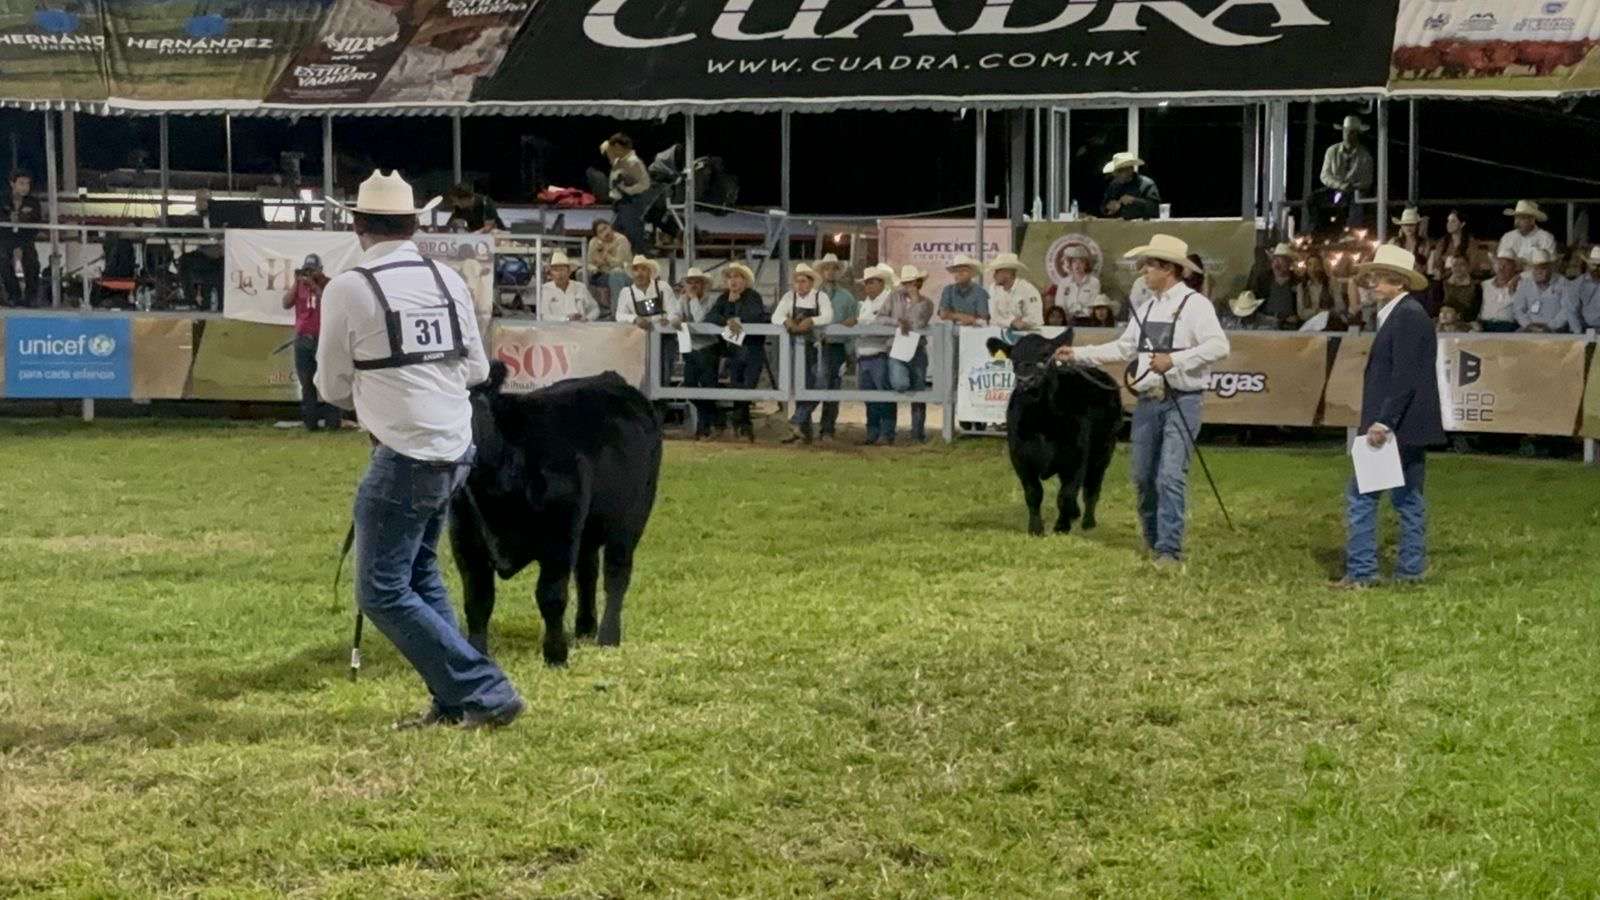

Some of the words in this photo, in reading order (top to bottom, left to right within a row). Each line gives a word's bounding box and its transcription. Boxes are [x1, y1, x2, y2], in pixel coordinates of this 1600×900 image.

[0, 32, 105, 46] HERNÁND
[707, 50, 1140, 73] WWW.CUADRA.COM.MX
[415, 319, 443, 345] 31
[19, 335, 86, 355] unicef
[18, 370, 42, 380] para
[44, 369, 71, 379] cada
[968, 373, 1014, 391] MUCH
[1450, 393, 1495, 406] UPO
